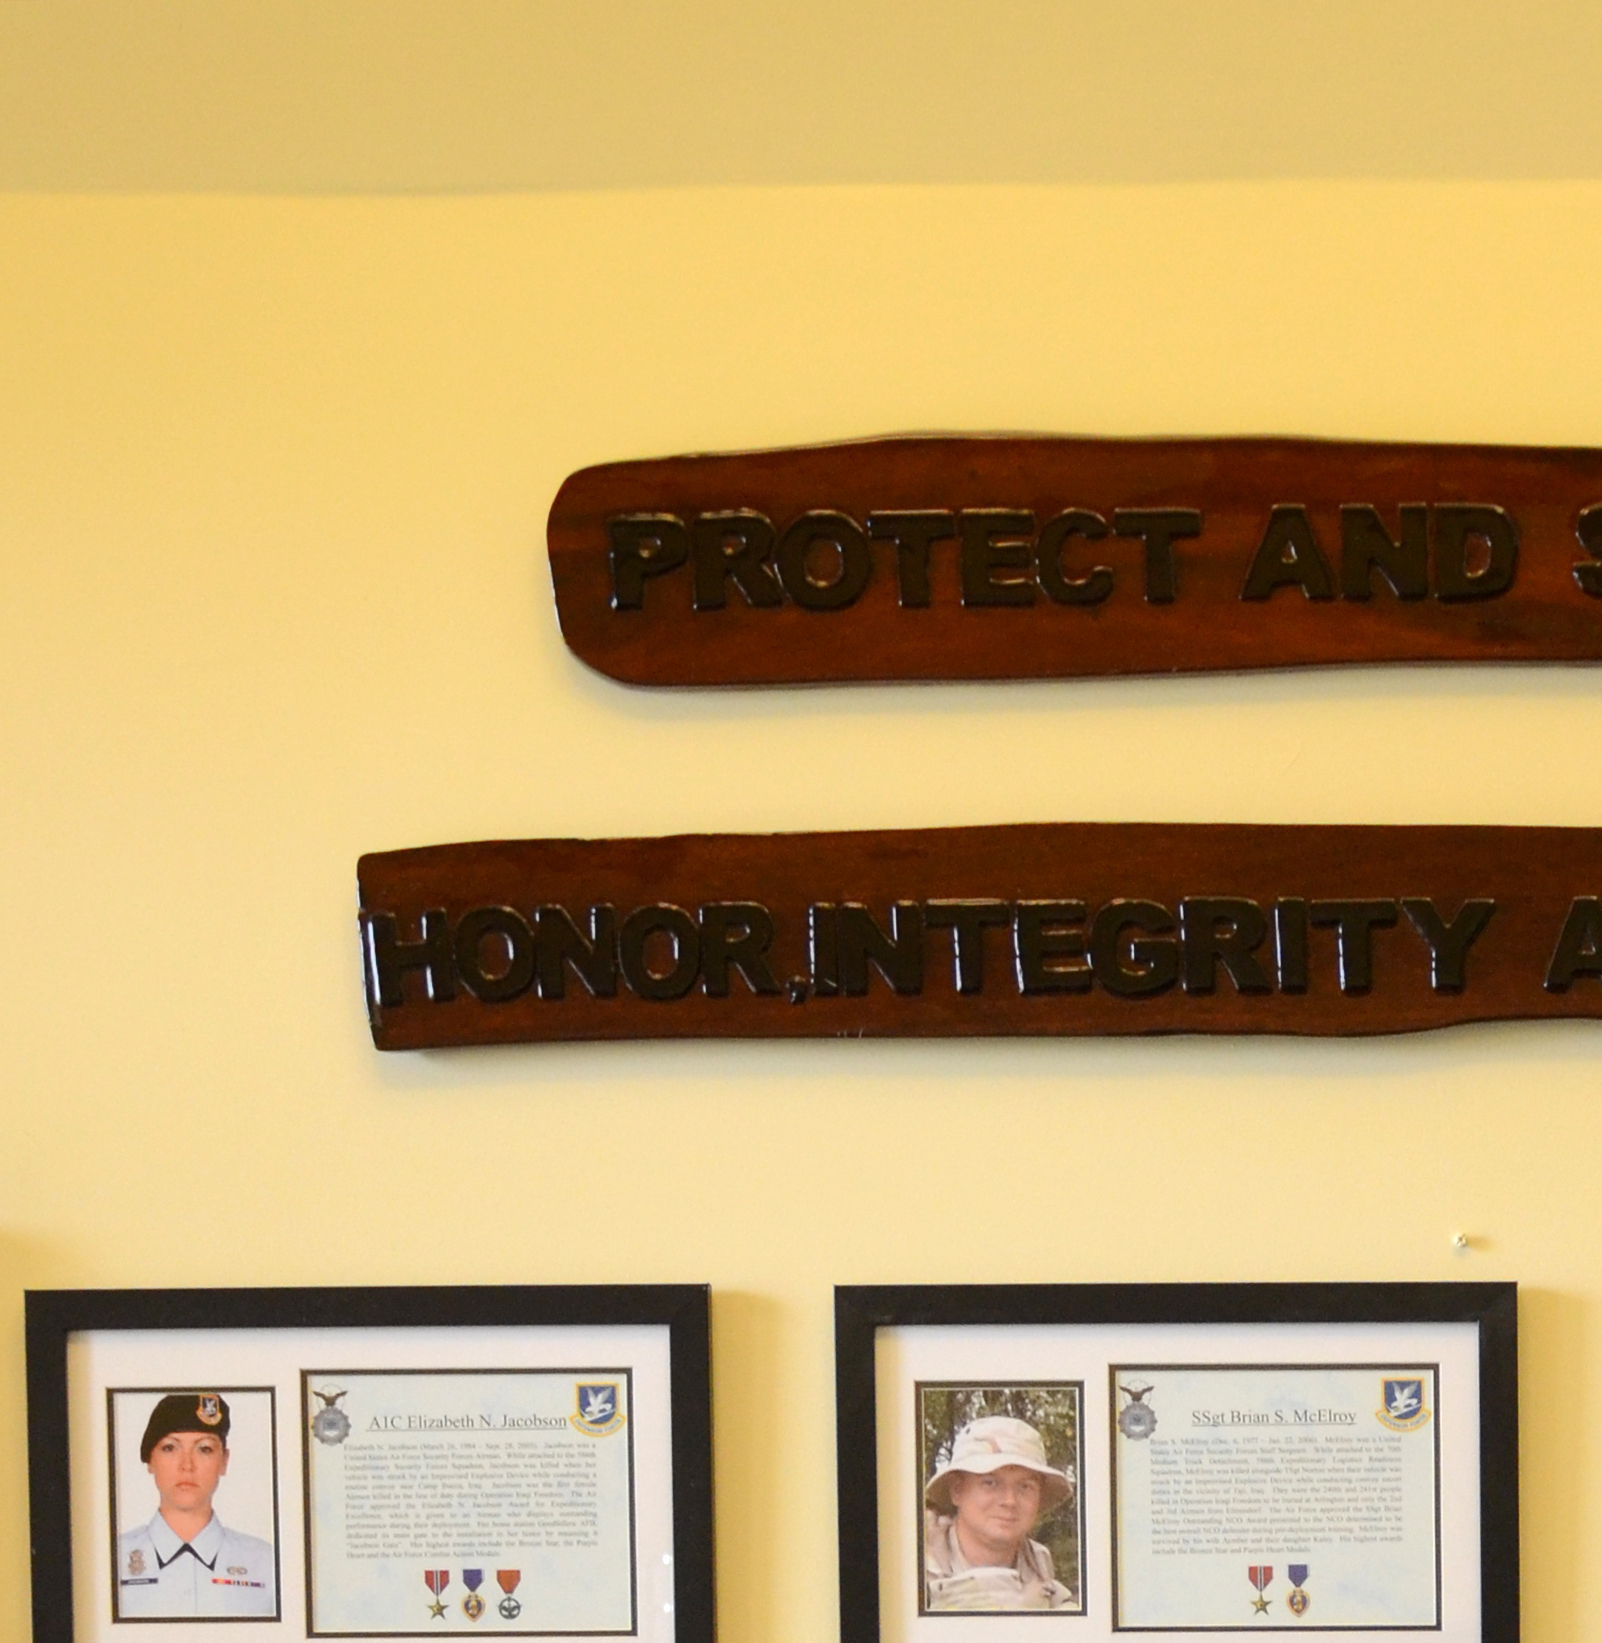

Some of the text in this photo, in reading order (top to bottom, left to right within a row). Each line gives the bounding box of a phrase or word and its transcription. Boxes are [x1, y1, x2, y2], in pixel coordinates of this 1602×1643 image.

[610, 504, 1200, 612] PROTECT
[1240, 501, 1519, 604] AND
[370, 1416, 403, 1429] A1C
[407, 1415, 474, 1429] Elizabeth
[501, 1414, 566, 1427] Jacobson
[1192, 1410, 1226, 1426] SSgt
[1231, 1410, 1269, 1423] Brian
[1294, 1410, 1356, 1425] McElroy
